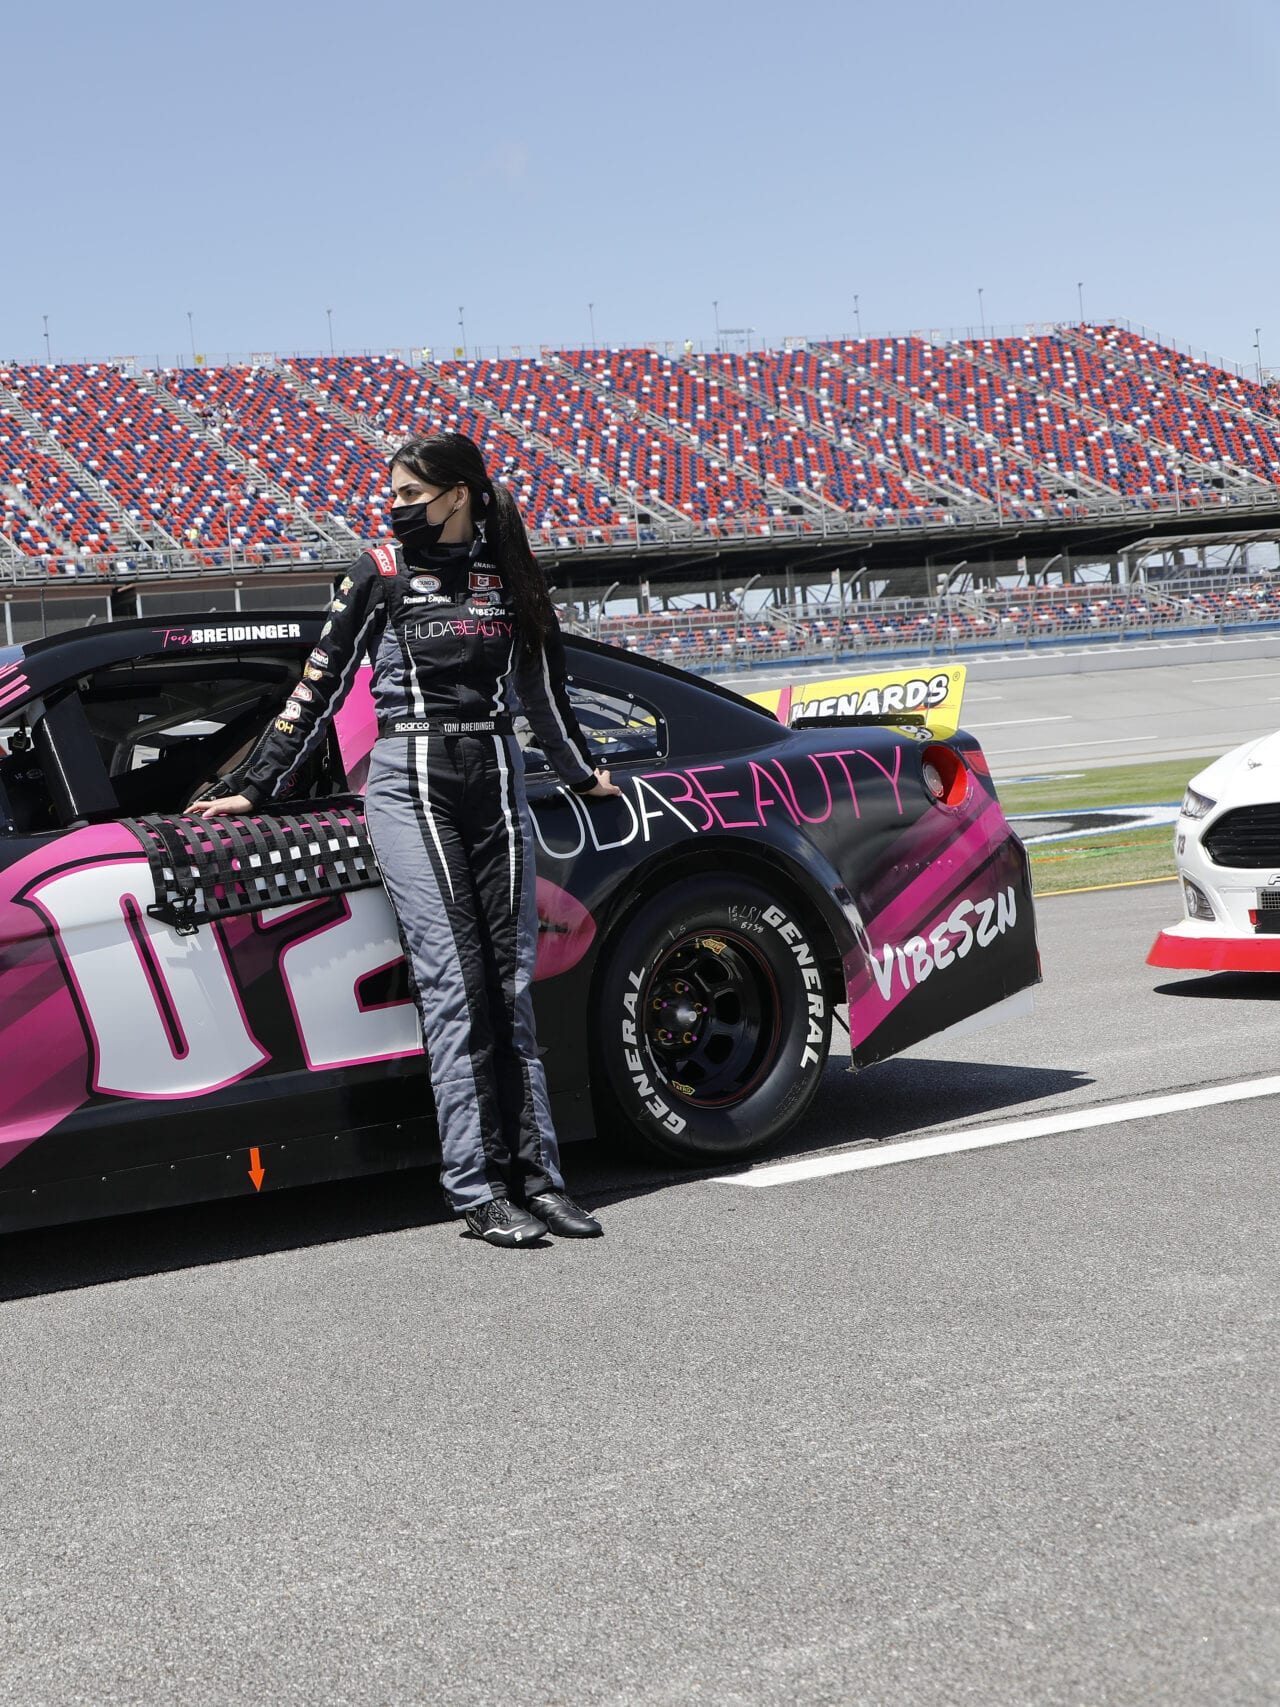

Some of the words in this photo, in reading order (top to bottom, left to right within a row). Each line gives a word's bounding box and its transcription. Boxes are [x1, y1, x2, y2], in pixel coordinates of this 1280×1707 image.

[191, 624, 300, 643] BREIDINGER
[394, 722, 430, 732] sparco
[443, 723, 460, 733] TONI
[461, 721, 495, 732] BREIDINGER
[791, 674, 950, 719] MENARDS
[528, 745, 905, 859] UDABEAUTY
[869, 887, 1017, 1001] VIBESZN
[762, 905, 824, 1068] GENERAL
[622, 967, 687, 1135] GENERAL
